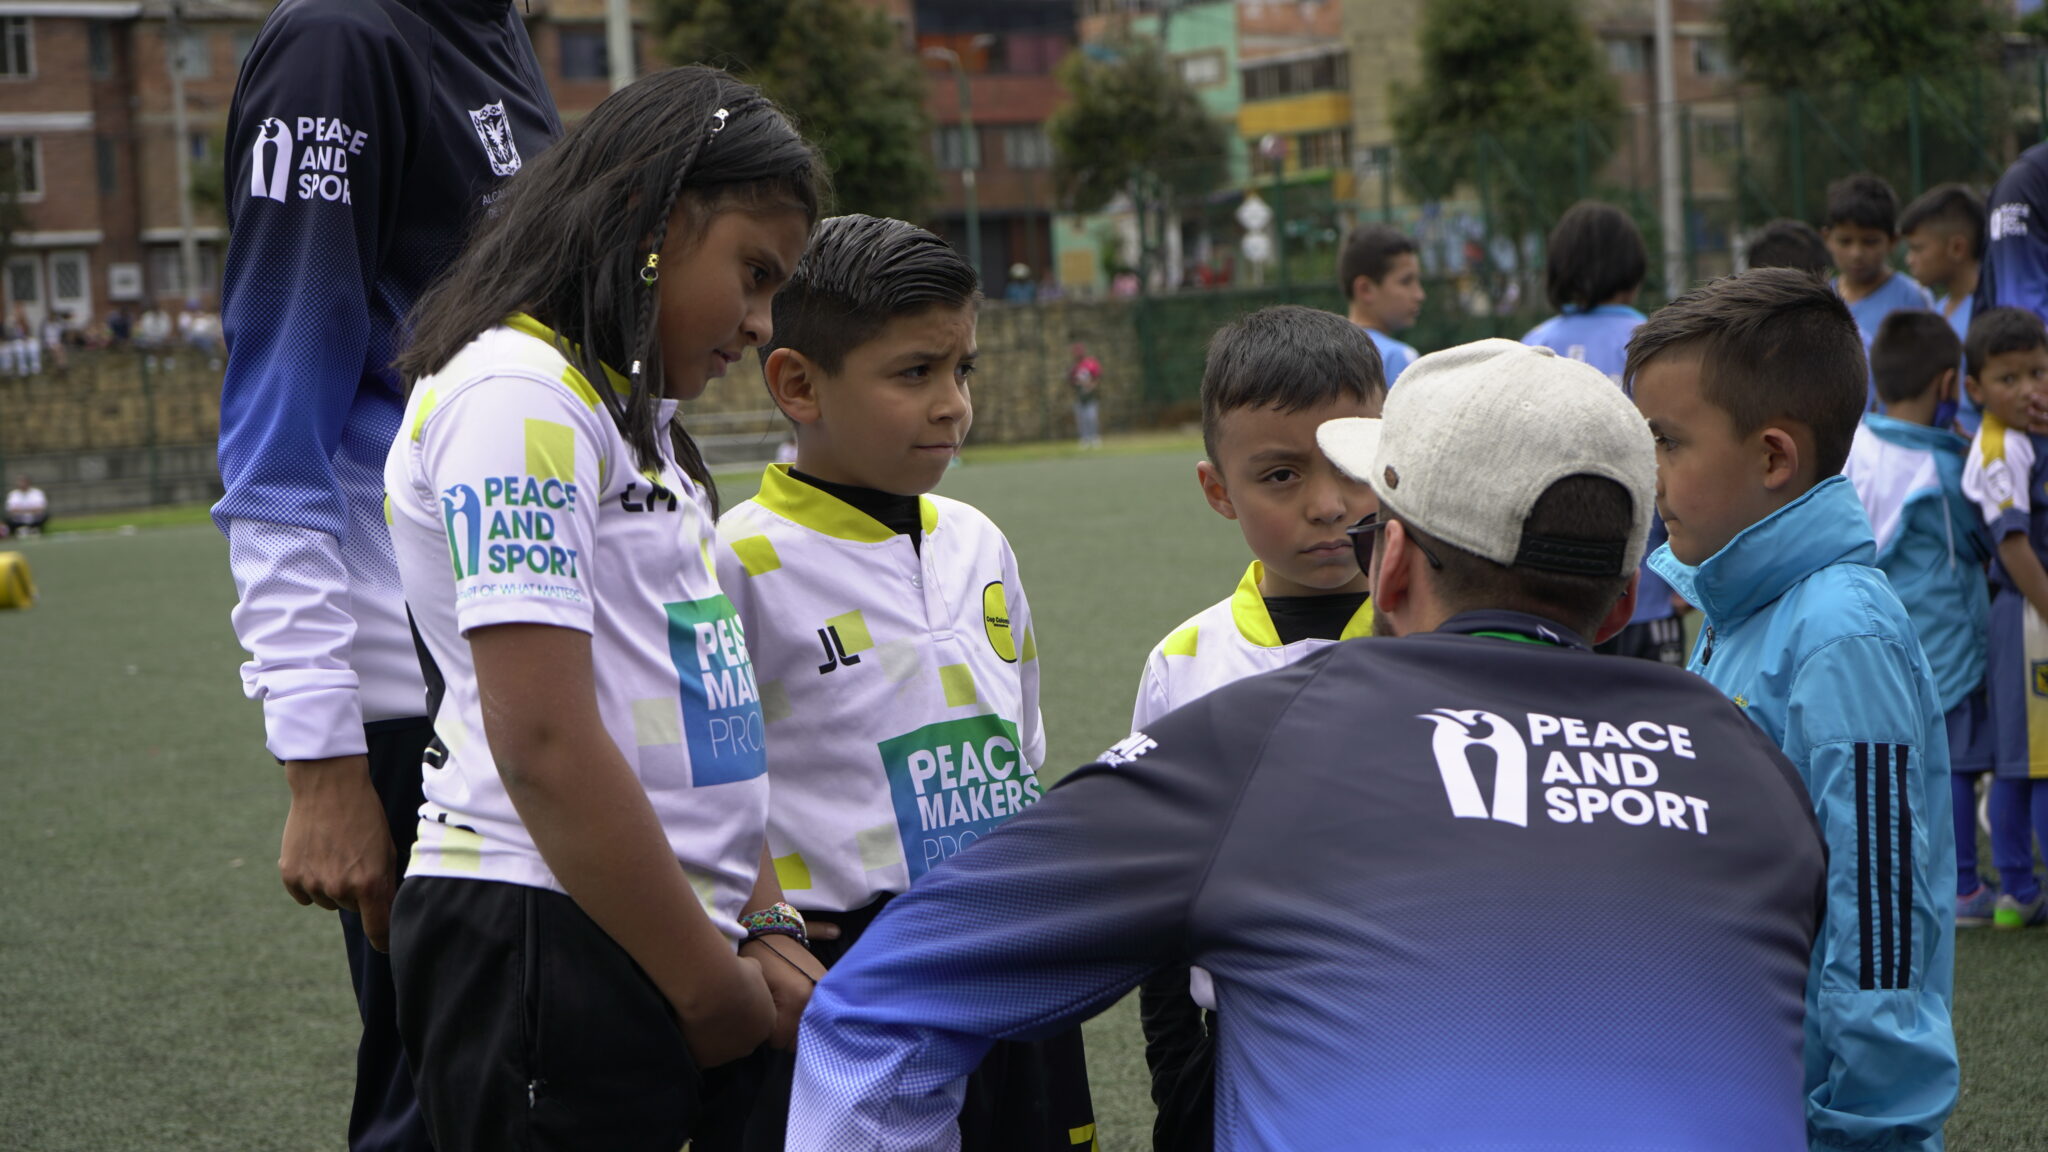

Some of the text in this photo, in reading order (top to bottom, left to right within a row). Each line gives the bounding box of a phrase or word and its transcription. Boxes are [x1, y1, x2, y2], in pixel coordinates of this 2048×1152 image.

[297, 116, 368, 155] PEACE
[299, 146, 347, 173] AND
[298, 173, 352, 205] SPOR
[484, 476, 577, 513] PEACE
[487, 510, 555, 541] AND
[488, 544, 577, 579] SPORT
[500, 583, 534, 597] WHAT
[693, 614, 750, 672] PEA
[709, 711, 765, 759] PRO
[1526, 713, 1696, 759] PEACE
[1541, 751, 1659, 786] AND
[917, 776, 1042, 831] MAKERS
[1545, 786, 1710, 835] SPORT
